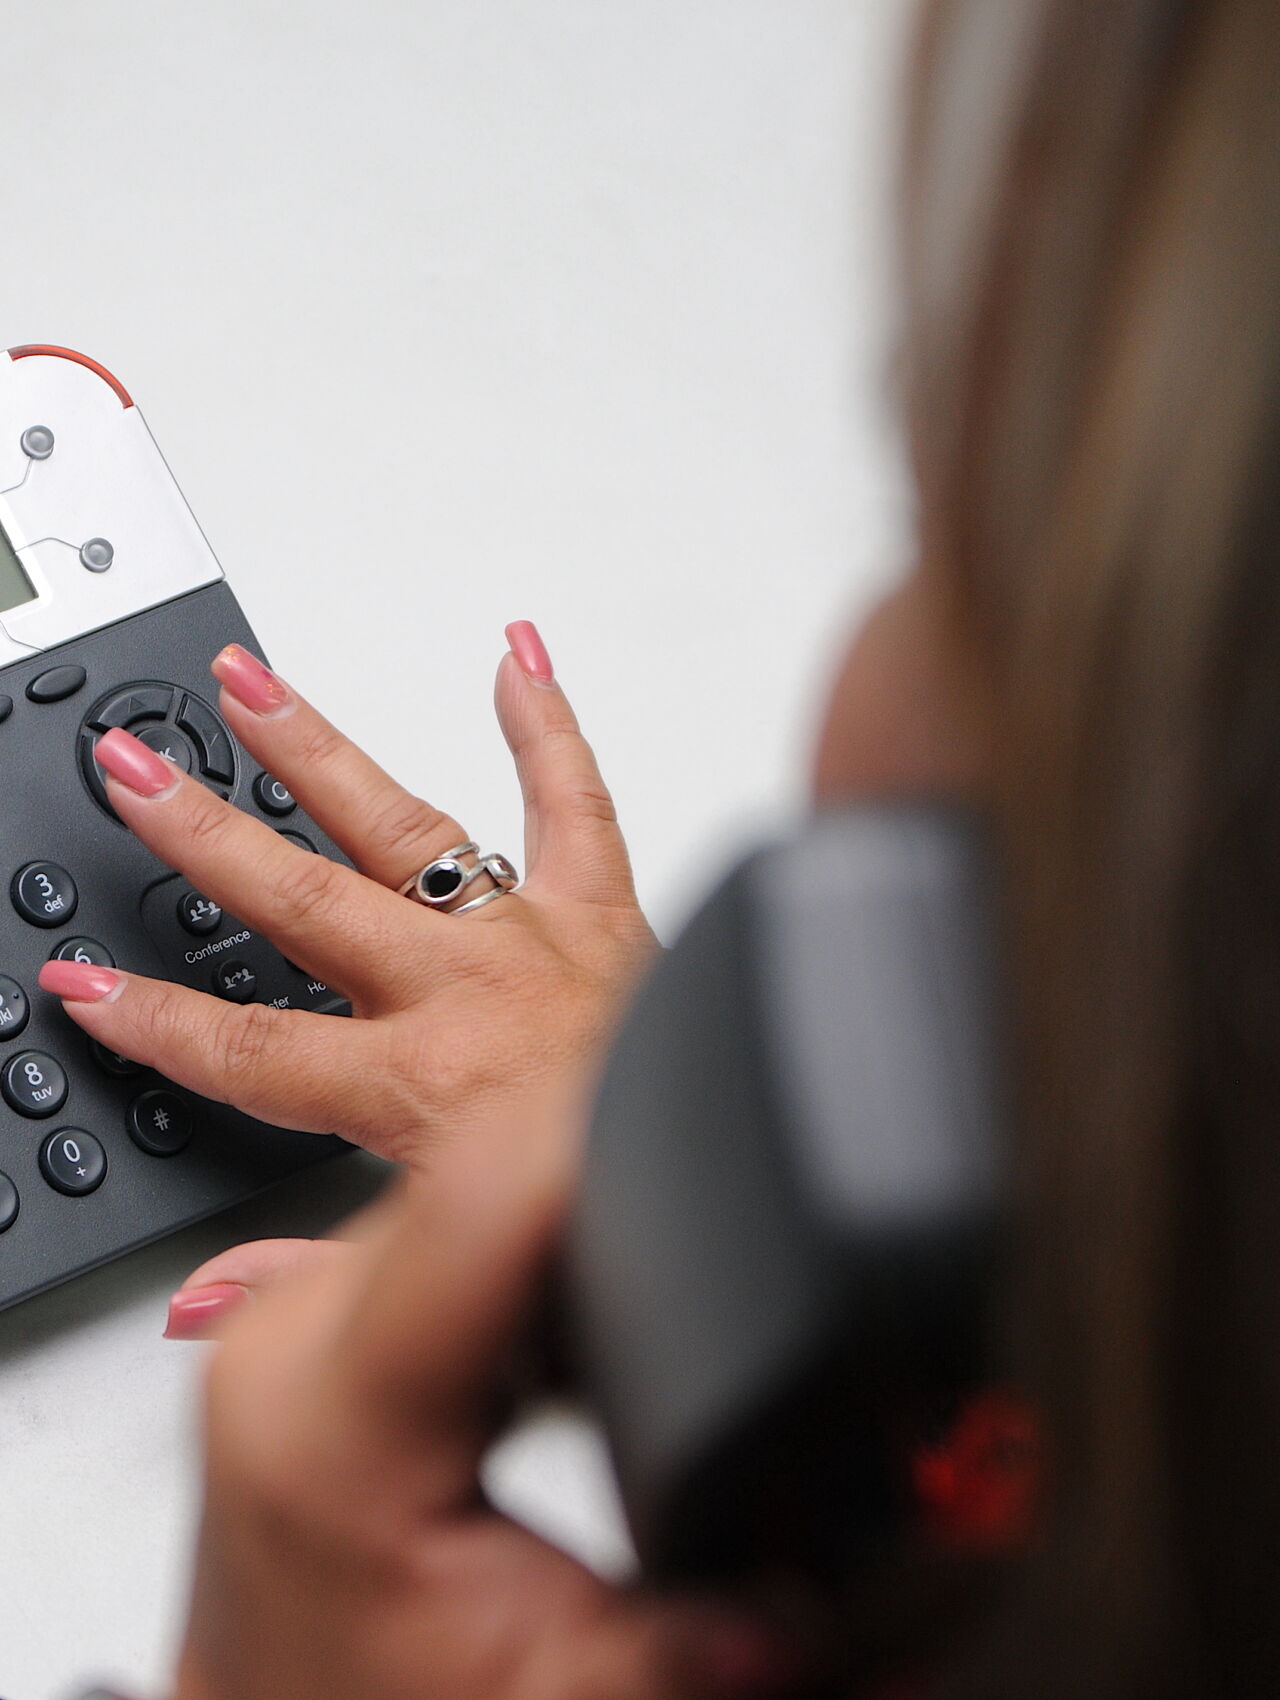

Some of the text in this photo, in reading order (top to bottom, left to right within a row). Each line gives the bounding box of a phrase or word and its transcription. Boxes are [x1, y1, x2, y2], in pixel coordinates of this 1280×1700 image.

[272, 782, 288, 800] C
[34, 873, 53, 896] 3
[44, 895, 65, 913] def
[75, 947, 91, 965] 6
[185, 929, 251, 963] Conference
[307, 982, 327, 995] Ho
[24, 1062, 43, 1084] 8
[32, 1085, 53, 1101] tuv
[153, 1108, 170, 1131] #
[63, 1138, 81, 1163] 0
